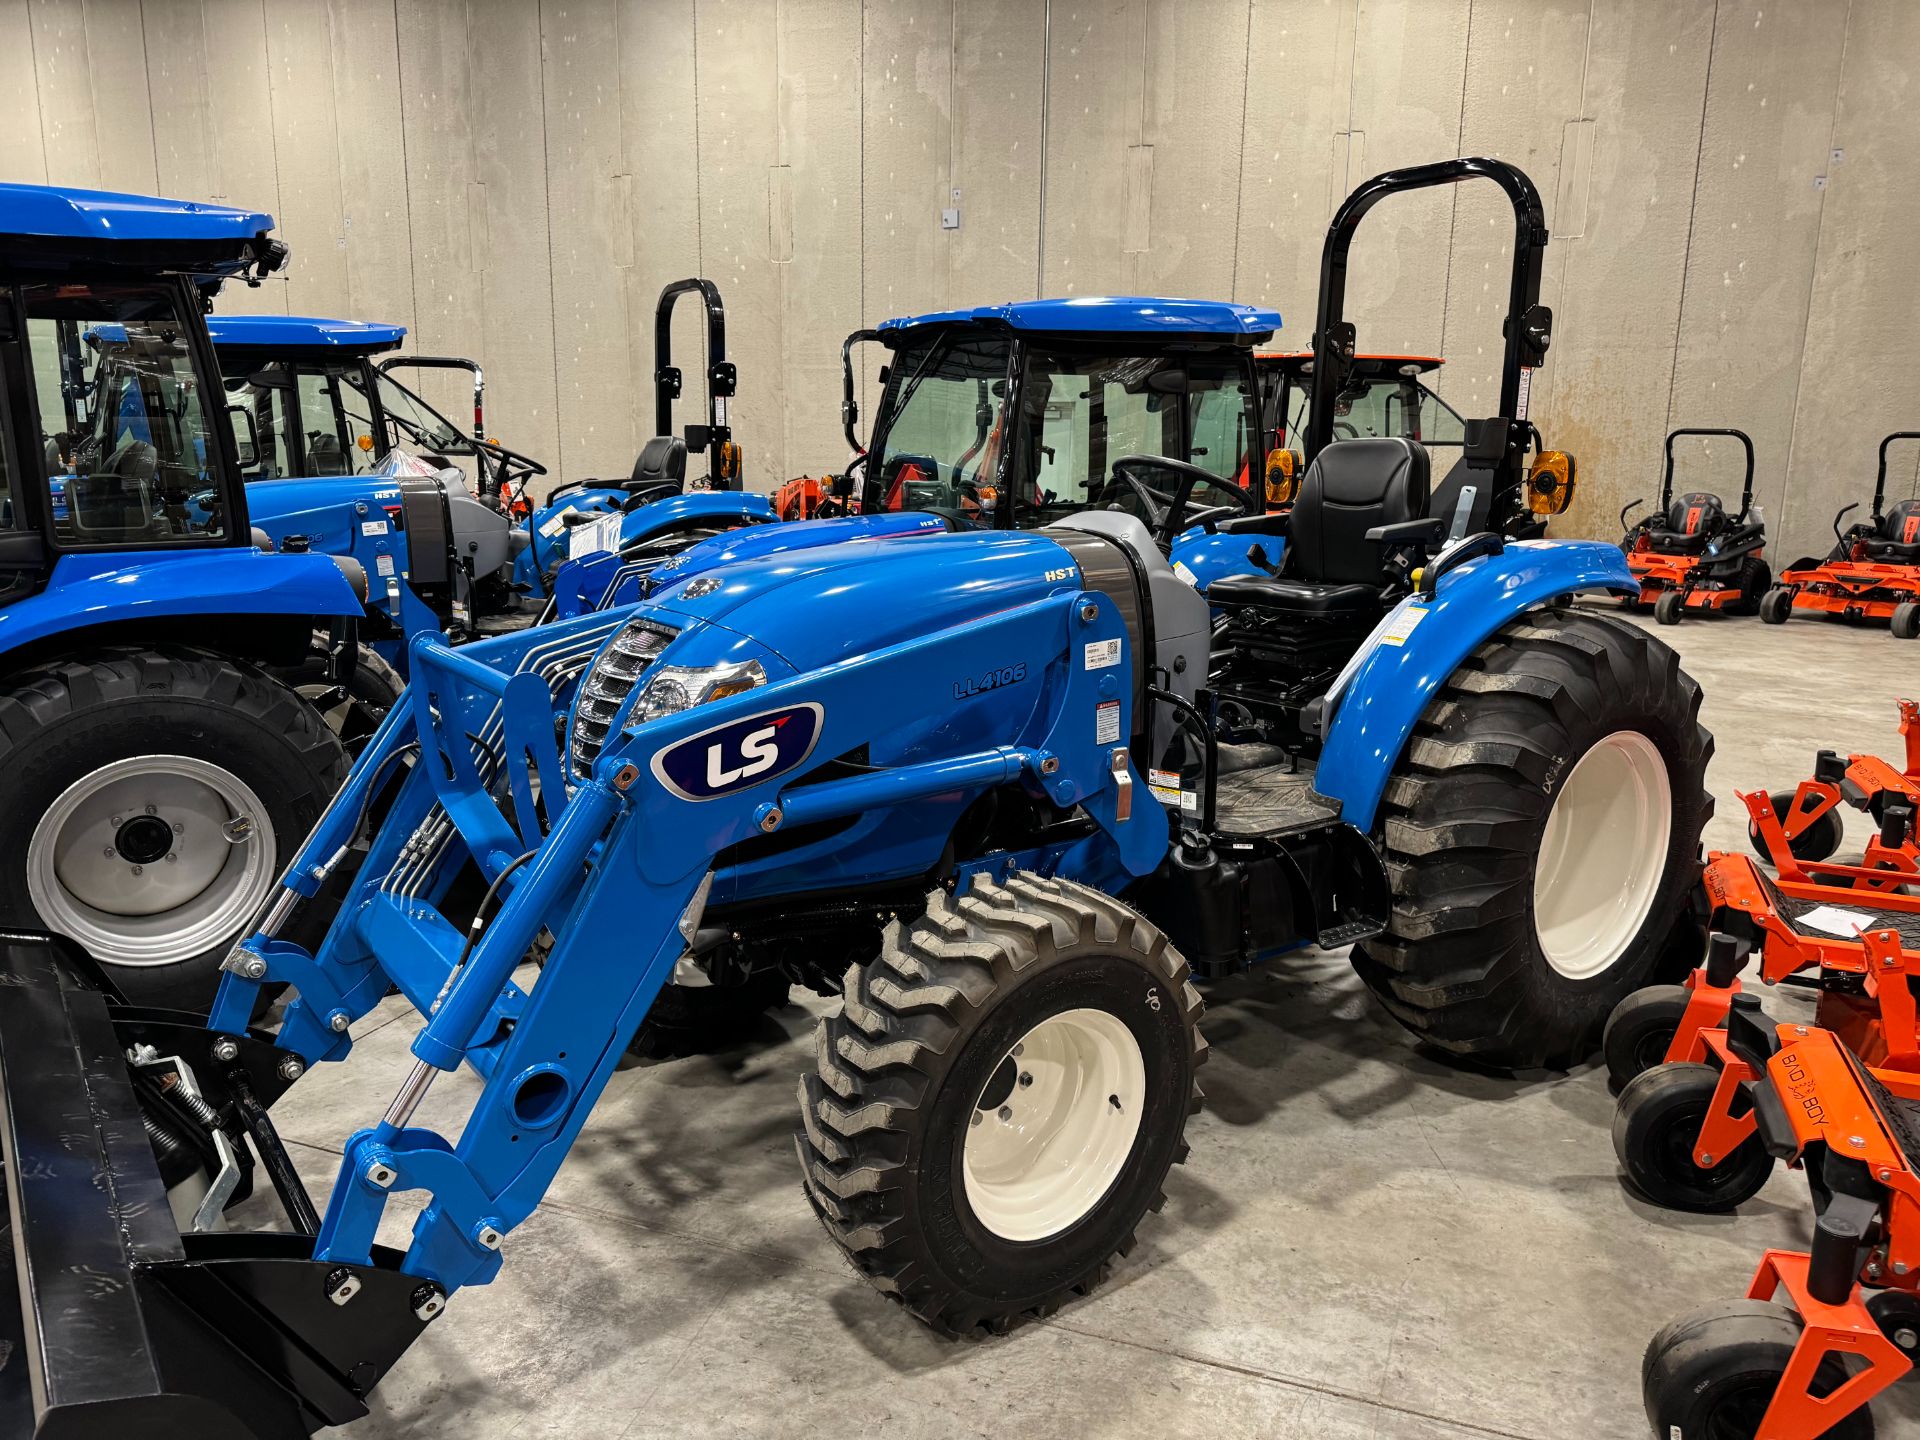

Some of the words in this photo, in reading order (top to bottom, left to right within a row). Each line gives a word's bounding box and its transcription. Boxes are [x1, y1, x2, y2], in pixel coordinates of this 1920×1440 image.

[374, 492, 397, 500] HST
[919, 518, 942, 527] HST
[1044, 566, 1076, 582] HST
[953, 662, 1026, 700] LL4106
[706, 722, 784, 789] LS
[1781, 1054, 1805, 1082] BAD
[1802, 1096, 1830, 1126] BOY
